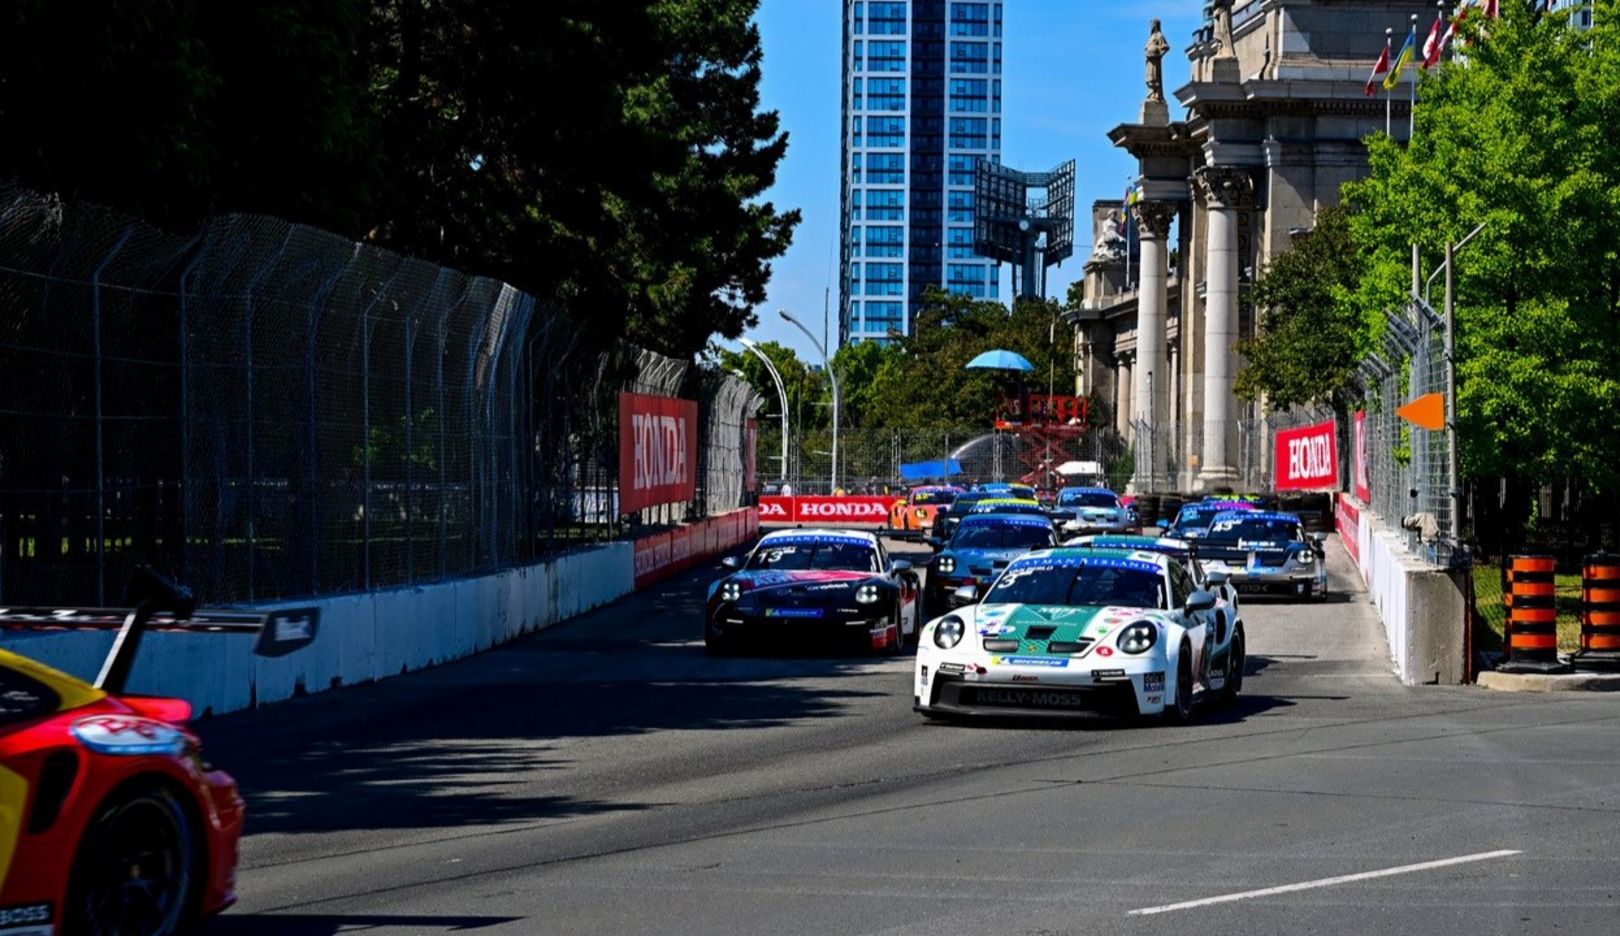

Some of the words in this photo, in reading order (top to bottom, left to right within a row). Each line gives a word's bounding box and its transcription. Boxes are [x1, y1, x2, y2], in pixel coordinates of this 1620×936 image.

[632, 413, 687, 489] HONDA
[1289, 434, 1332, 479] HONDA
[801, 503, 888, 516] HONDA
[764, 535, 812, 545] CAYMAN
[823, 536, 872, 546] ISLANDS
[758, 551, 783, 564] 13
[1013, 558, 1076, 568] CAYMAN
[1093, 558, 1159, 572] ISLANDS
[998, 574, 1018, 589] 3
[1012, 657, 1063, 666] MICHELIN
